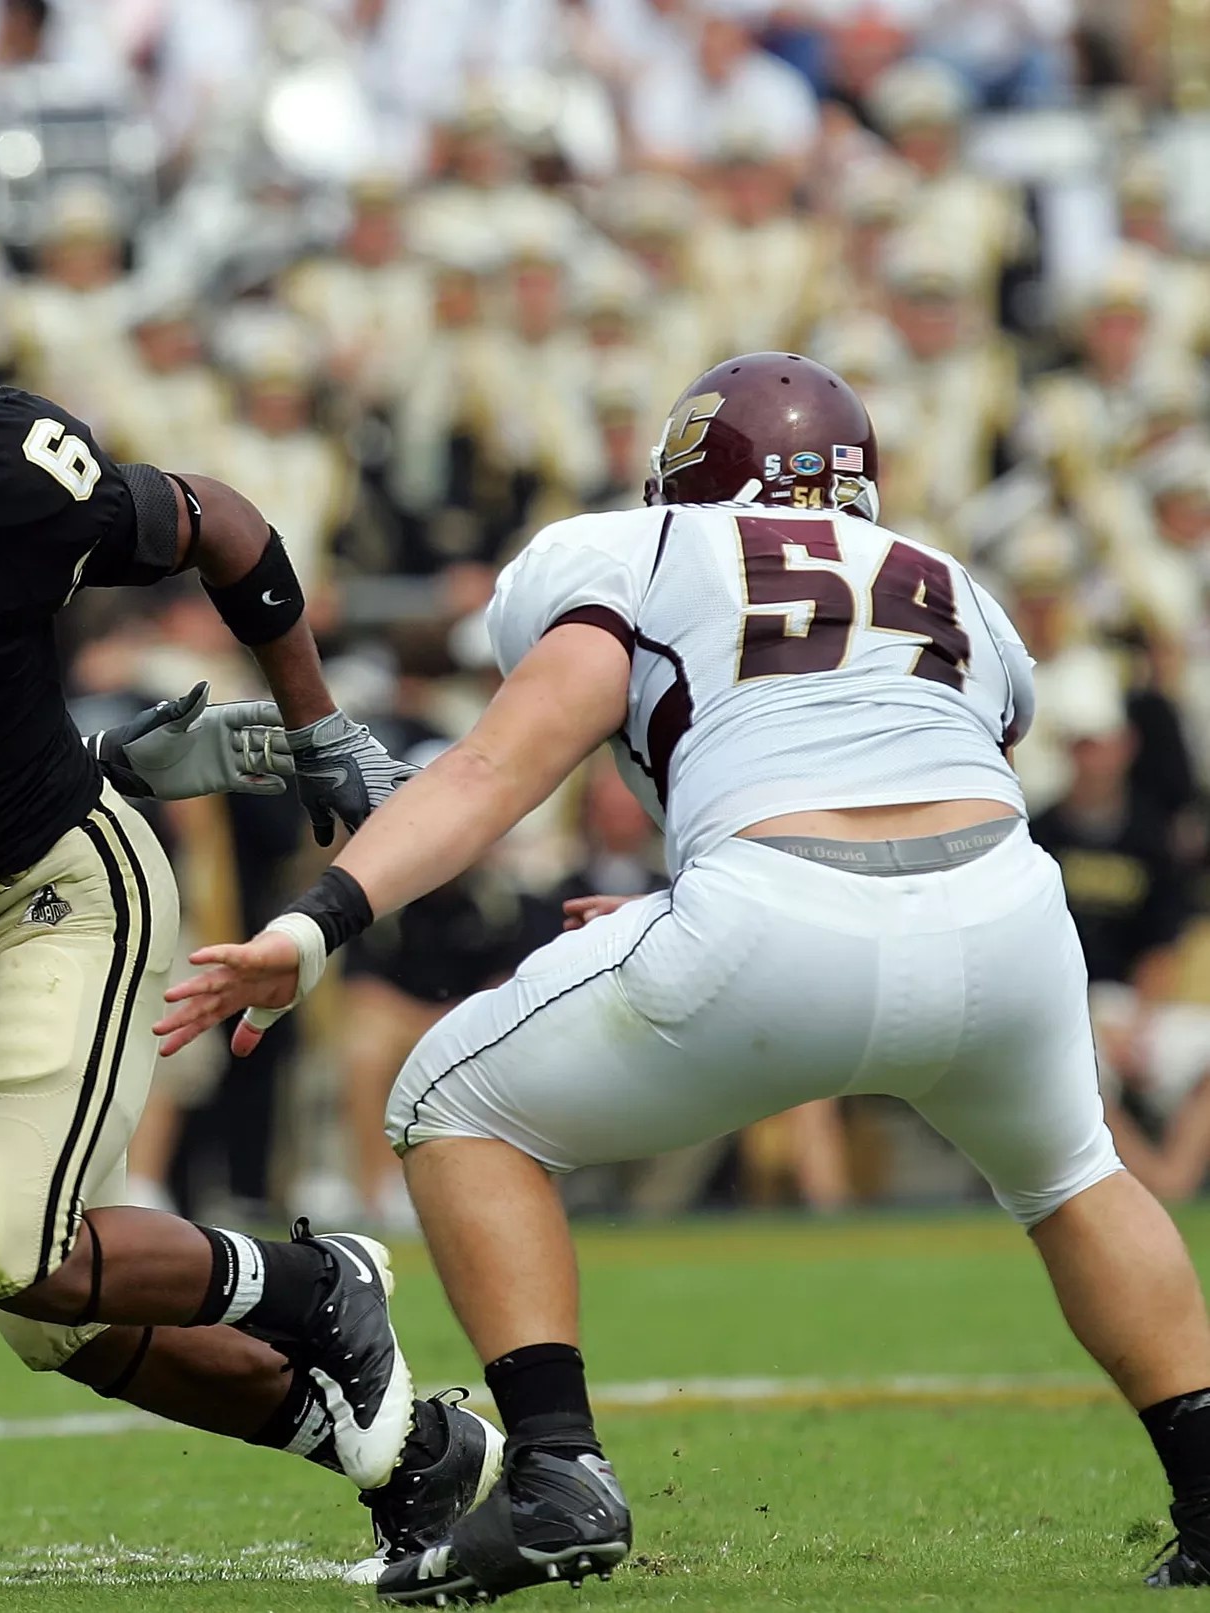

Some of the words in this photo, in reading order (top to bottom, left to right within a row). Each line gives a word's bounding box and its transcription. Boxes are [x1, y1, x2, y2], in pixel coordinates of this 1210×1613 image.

[21, 417, 102, 502] 6
[793, 485, 823, 509] 54
[733, 514, 972, 695] 54
